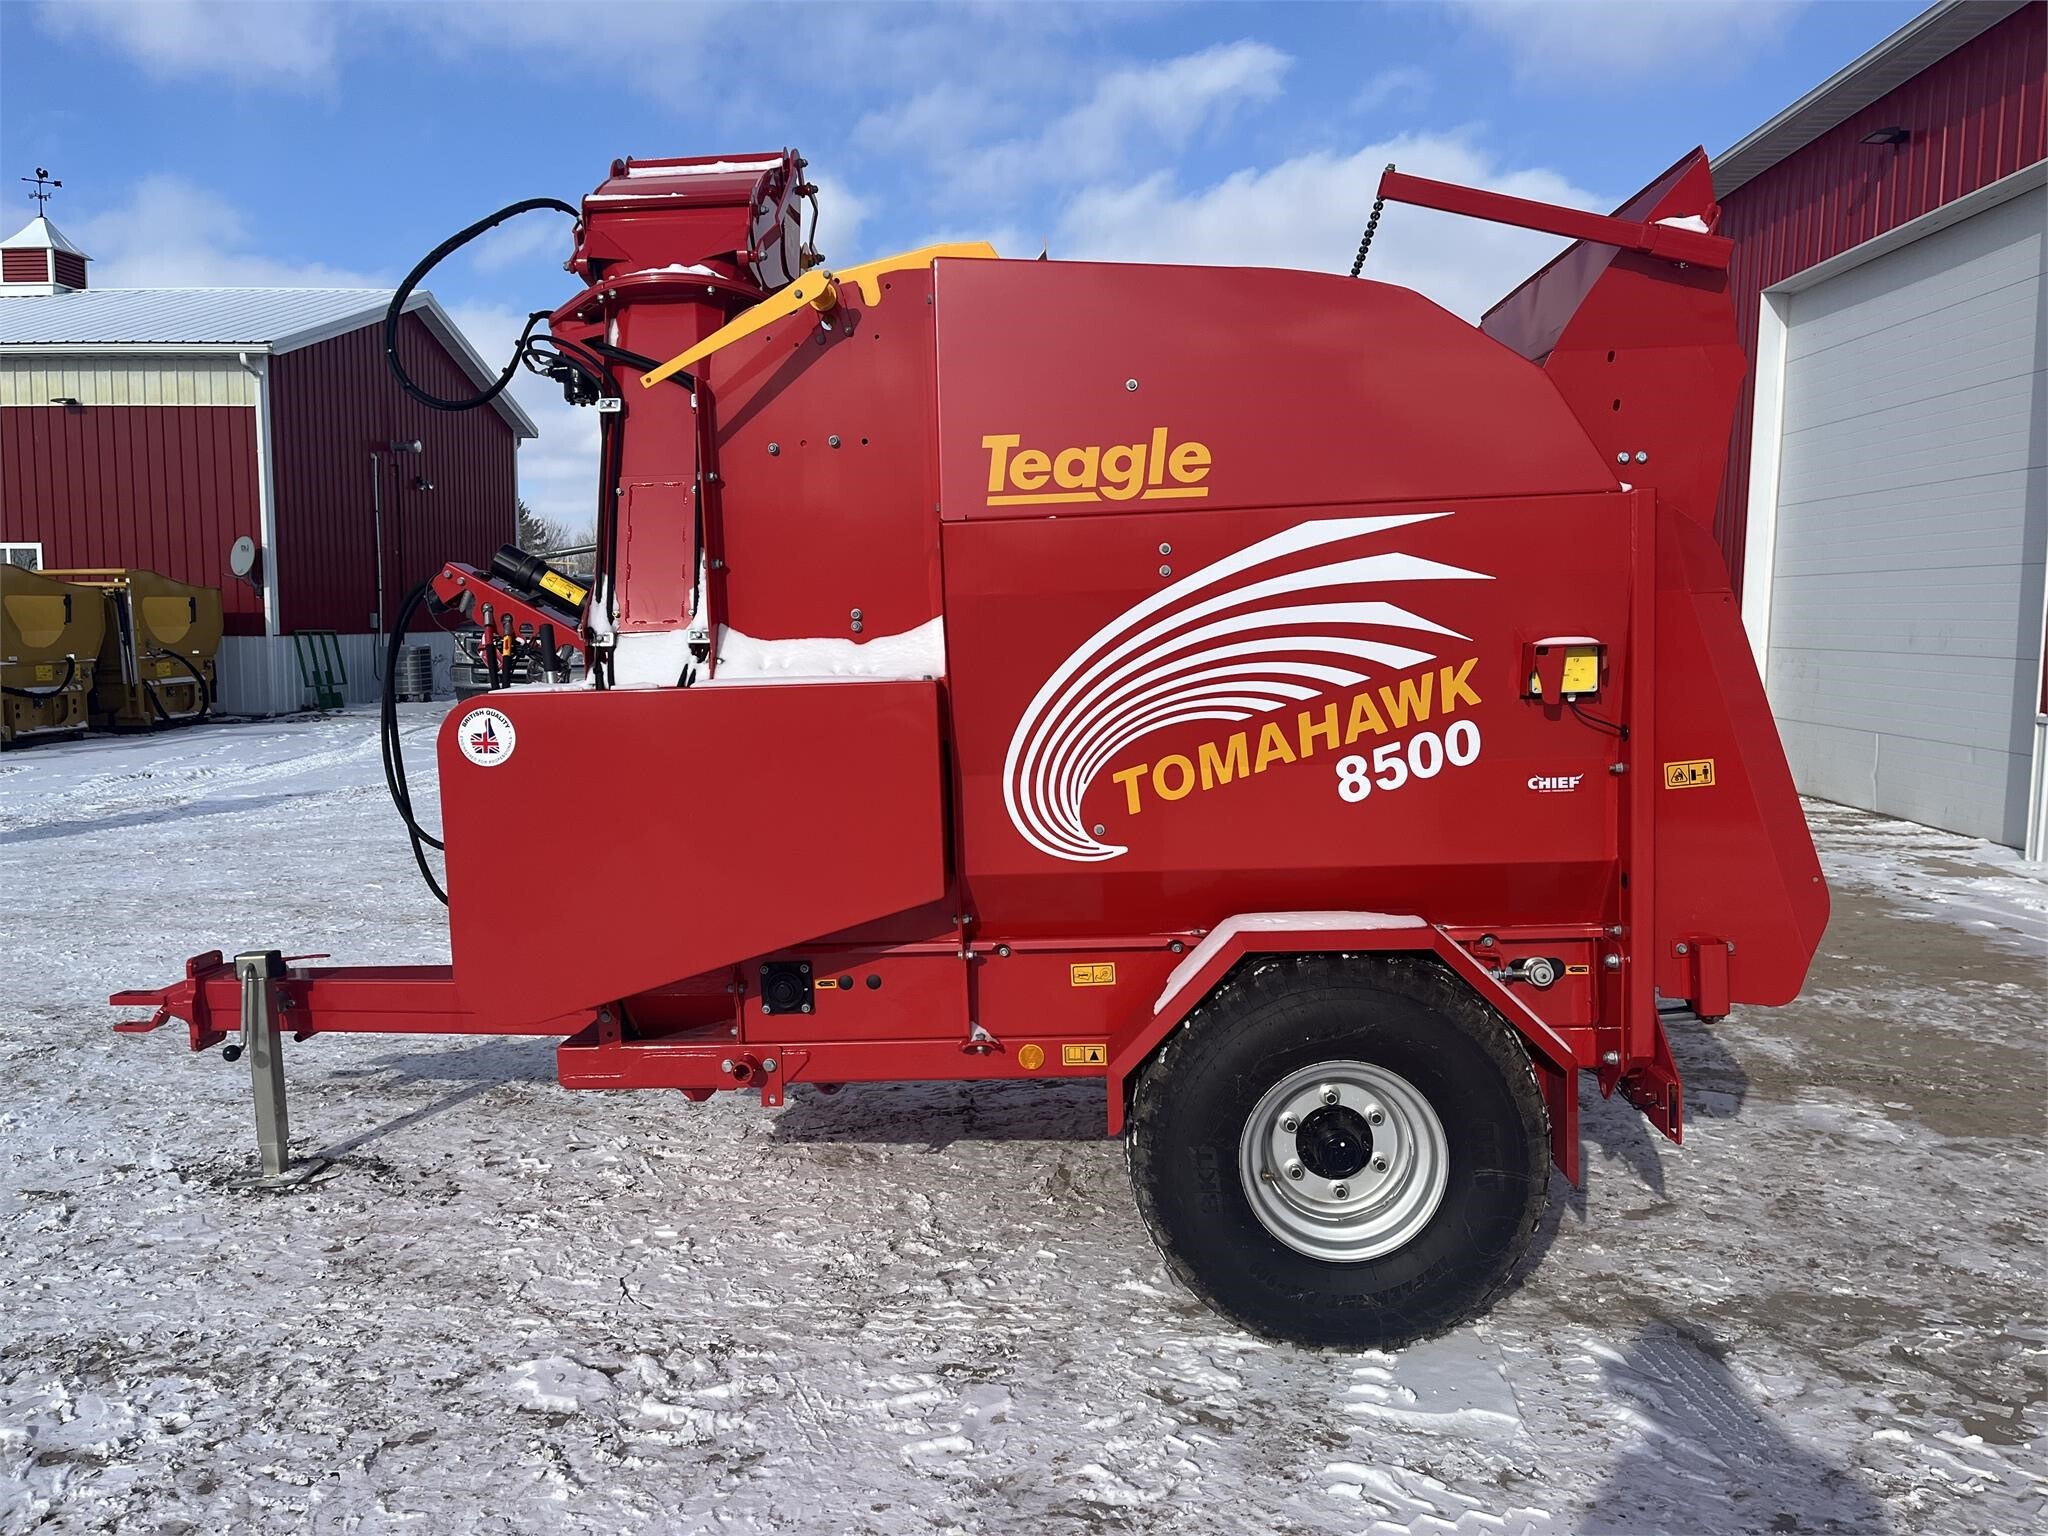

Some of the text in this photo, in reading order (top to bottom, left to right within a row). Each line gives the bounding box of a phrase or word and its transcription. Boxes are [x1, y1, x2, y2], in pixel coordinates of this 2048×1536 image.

[981, 427, 1212, 502] Teagle
[461, 710, 510, 729] BRITISH QUALITY
[1112, 657, 1482, 815] TOMAHAWK
[1335, 720, 1482, 803] 8500
[1527, 773, 1584, 790] CHIEF
